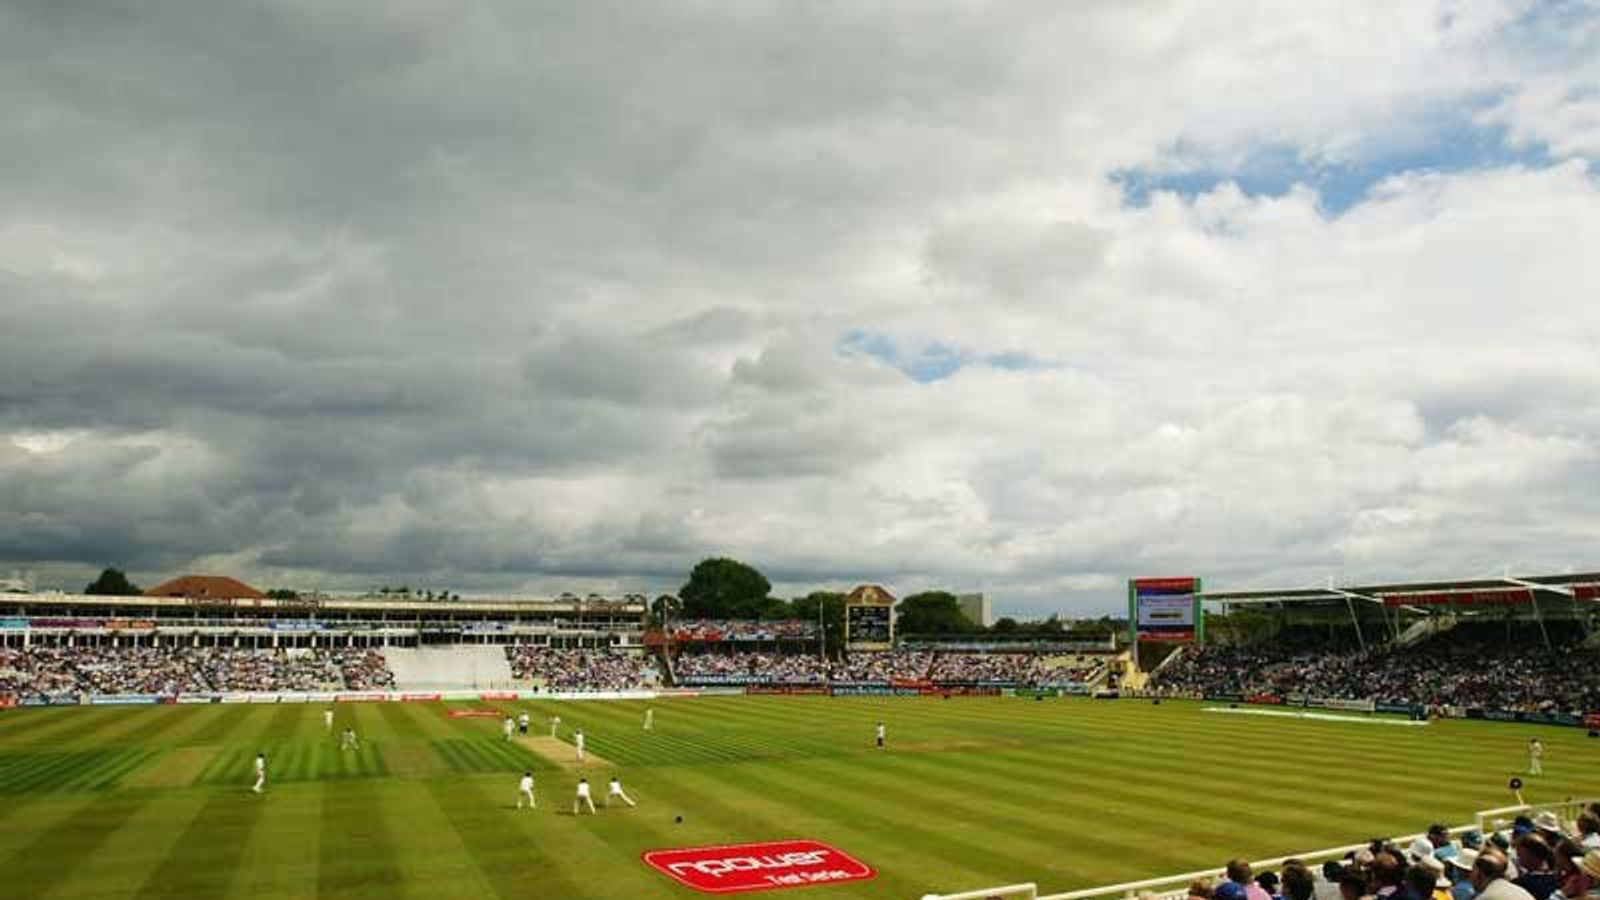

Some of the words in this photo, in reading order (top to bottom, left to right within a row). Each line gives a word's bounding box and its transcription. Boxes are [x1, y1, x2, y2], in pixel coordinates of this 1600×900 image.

[668, 850, 830, 877] npower
[763, 873, 803, 885] Test
[800, 870, 851, 882] Series
